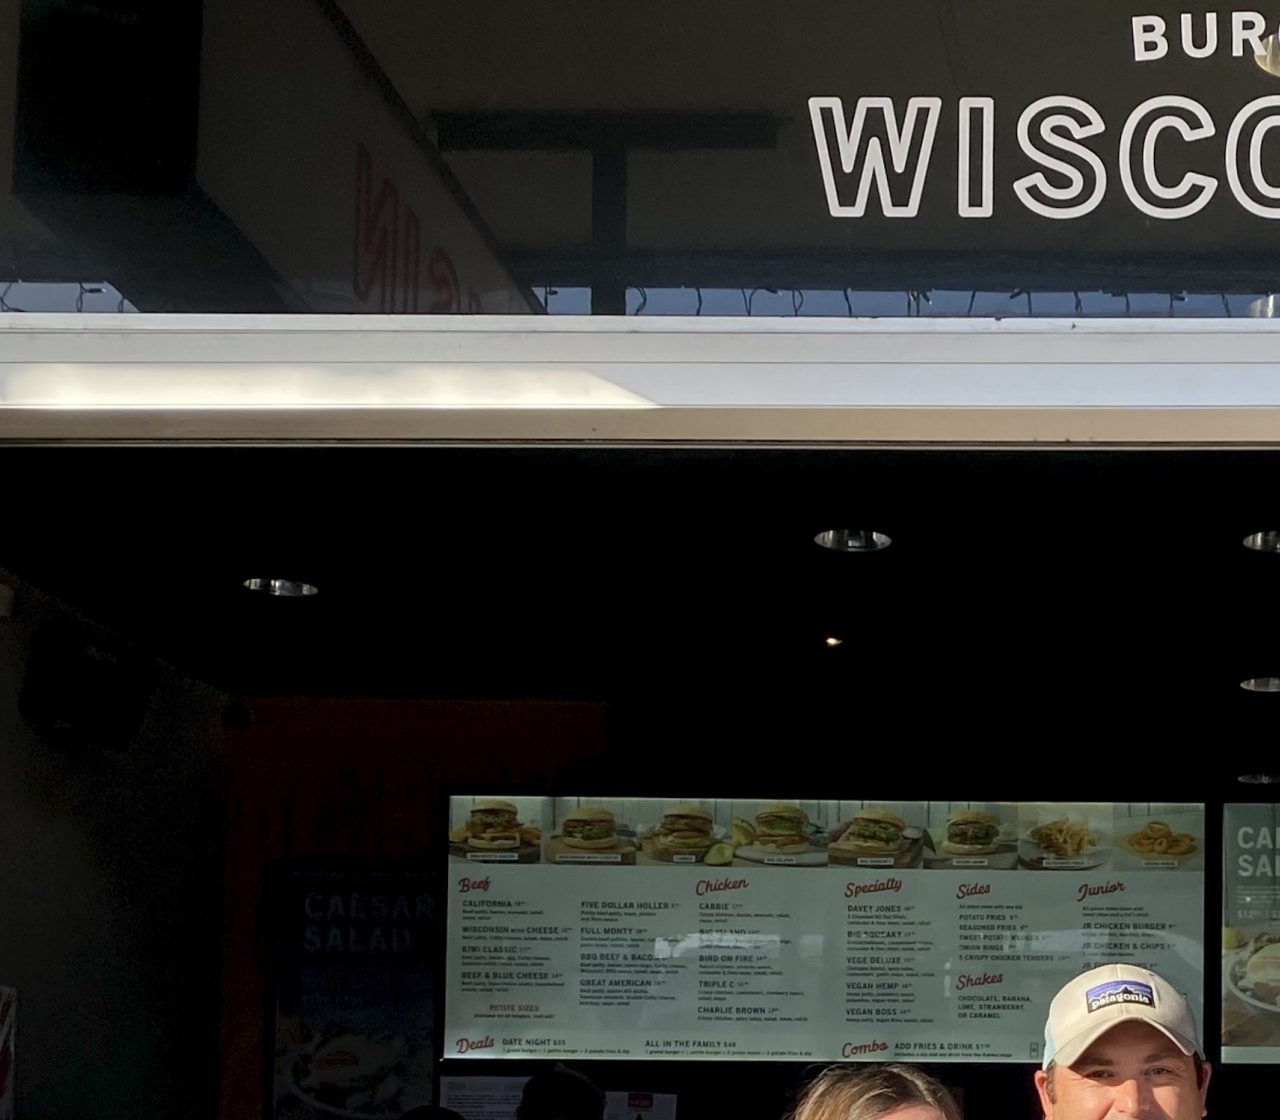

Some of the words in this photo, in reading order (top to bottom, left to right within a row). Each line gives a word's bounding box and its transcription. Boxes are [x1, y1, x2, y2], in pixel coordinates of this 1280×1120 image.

[458, 876, 492, 893] Beef
[696, 878, 750, 896] Chicken
[844, 878, 903, 898] Specialty
[956, 883, 992, 899] Sides
[1076, 881, 1126, 902] Junior
[305, 892, 435, 920] CAESAR
[581, 901, 599, 909] FIVE
[602, 901, 634, 909] DOLLAR
[637, 901, 669, 909] HOLLER
[462, 926, 509, 934] WISCONSIN
[527, 926, 559, 934] CHEESE
[304, 926, 414, 952] SALAD
[1094, 942, 1130, 950] CHICKEN
[1140, 942, 1165, 950] CHIPS
[698, 980, 727, 988] TRIPLE
[729, 980, 735, 988] C
[956, 973, 1003, 990] Shakes
[456, 1035, 495, 1054] Deals
[842, 1040, 889, 1058] Combo
